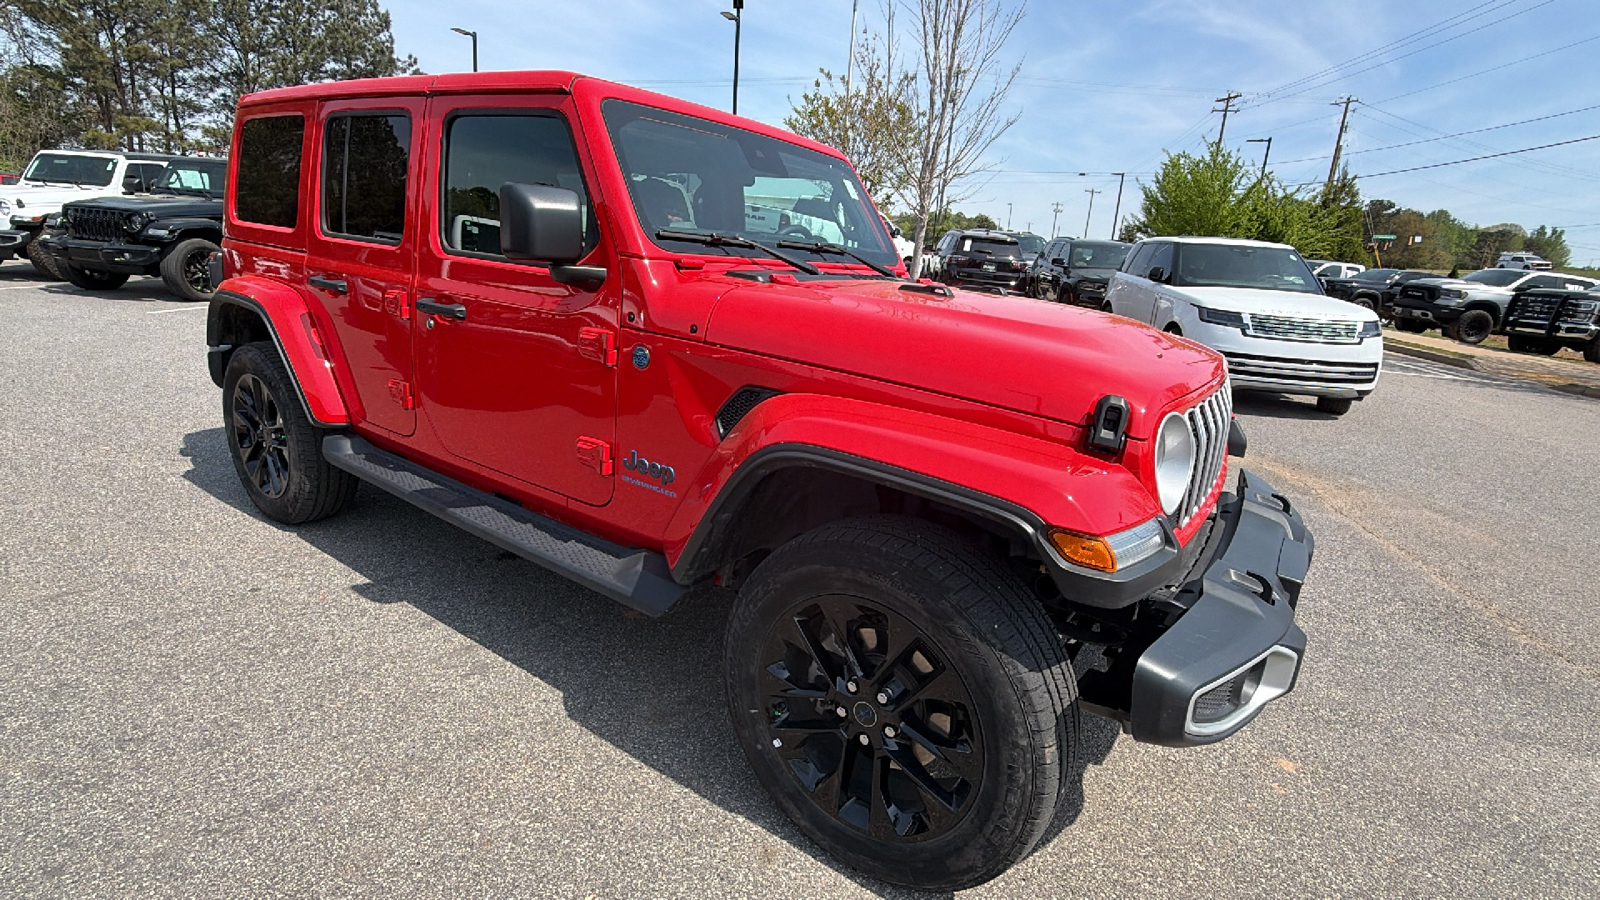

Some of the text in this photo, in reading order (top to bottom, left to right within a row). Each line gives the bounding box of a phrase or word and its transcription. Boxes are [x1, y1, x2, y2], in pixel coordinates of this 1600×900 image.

[745, 213, 765, 221] RAM
[623, 450, 675, 485] Jeep
[629, 478, 676, 498] WRANGLER
